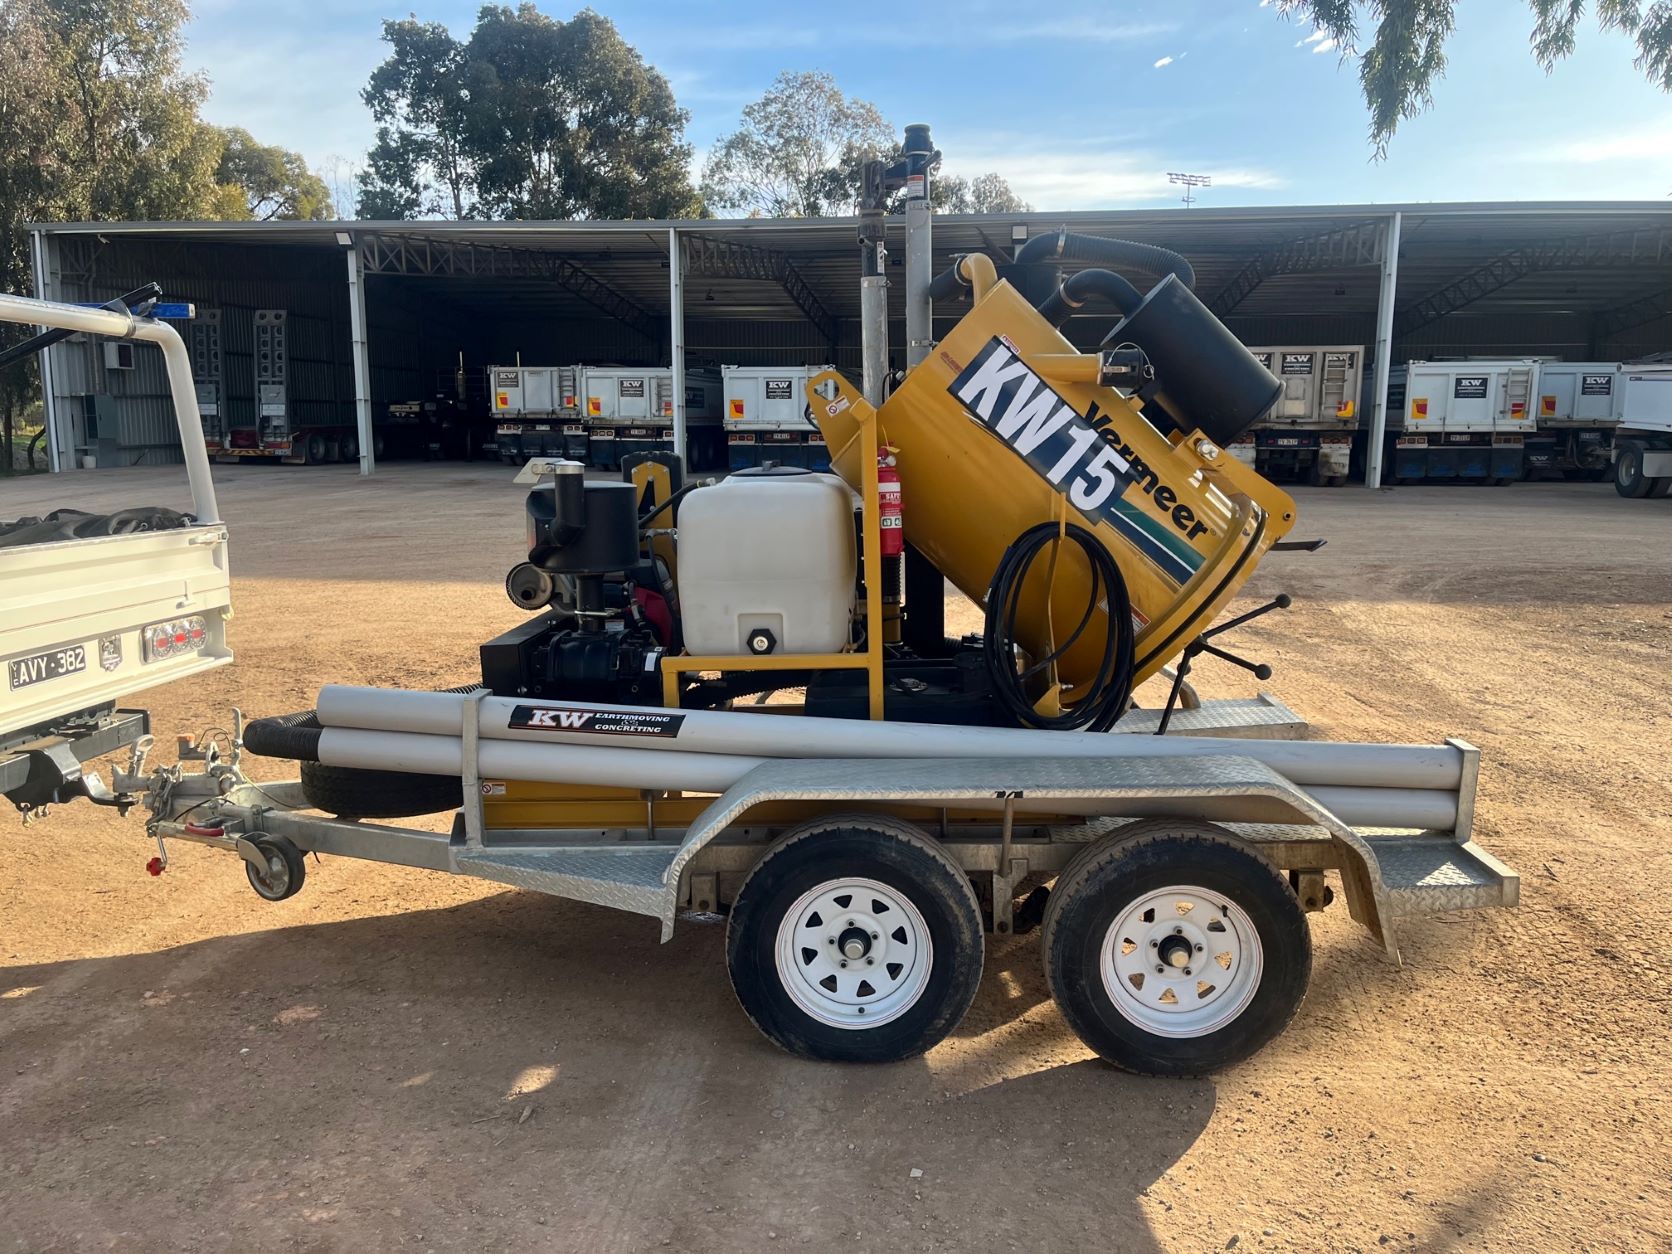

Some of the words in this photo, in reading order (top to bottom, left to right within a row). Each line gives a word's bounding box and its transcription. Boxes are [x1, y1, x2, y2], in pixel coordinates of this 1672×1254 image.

[1285, 354, 1311, 362] KW
[1585, 376, 1609, 384] KW
[958, 344, 1130, 511] KW15
[528, 709, 594, 728] KW
[595, 712, 671, 722] EARTHMOVING
[594, 724, 662, 733] CONCRETING
